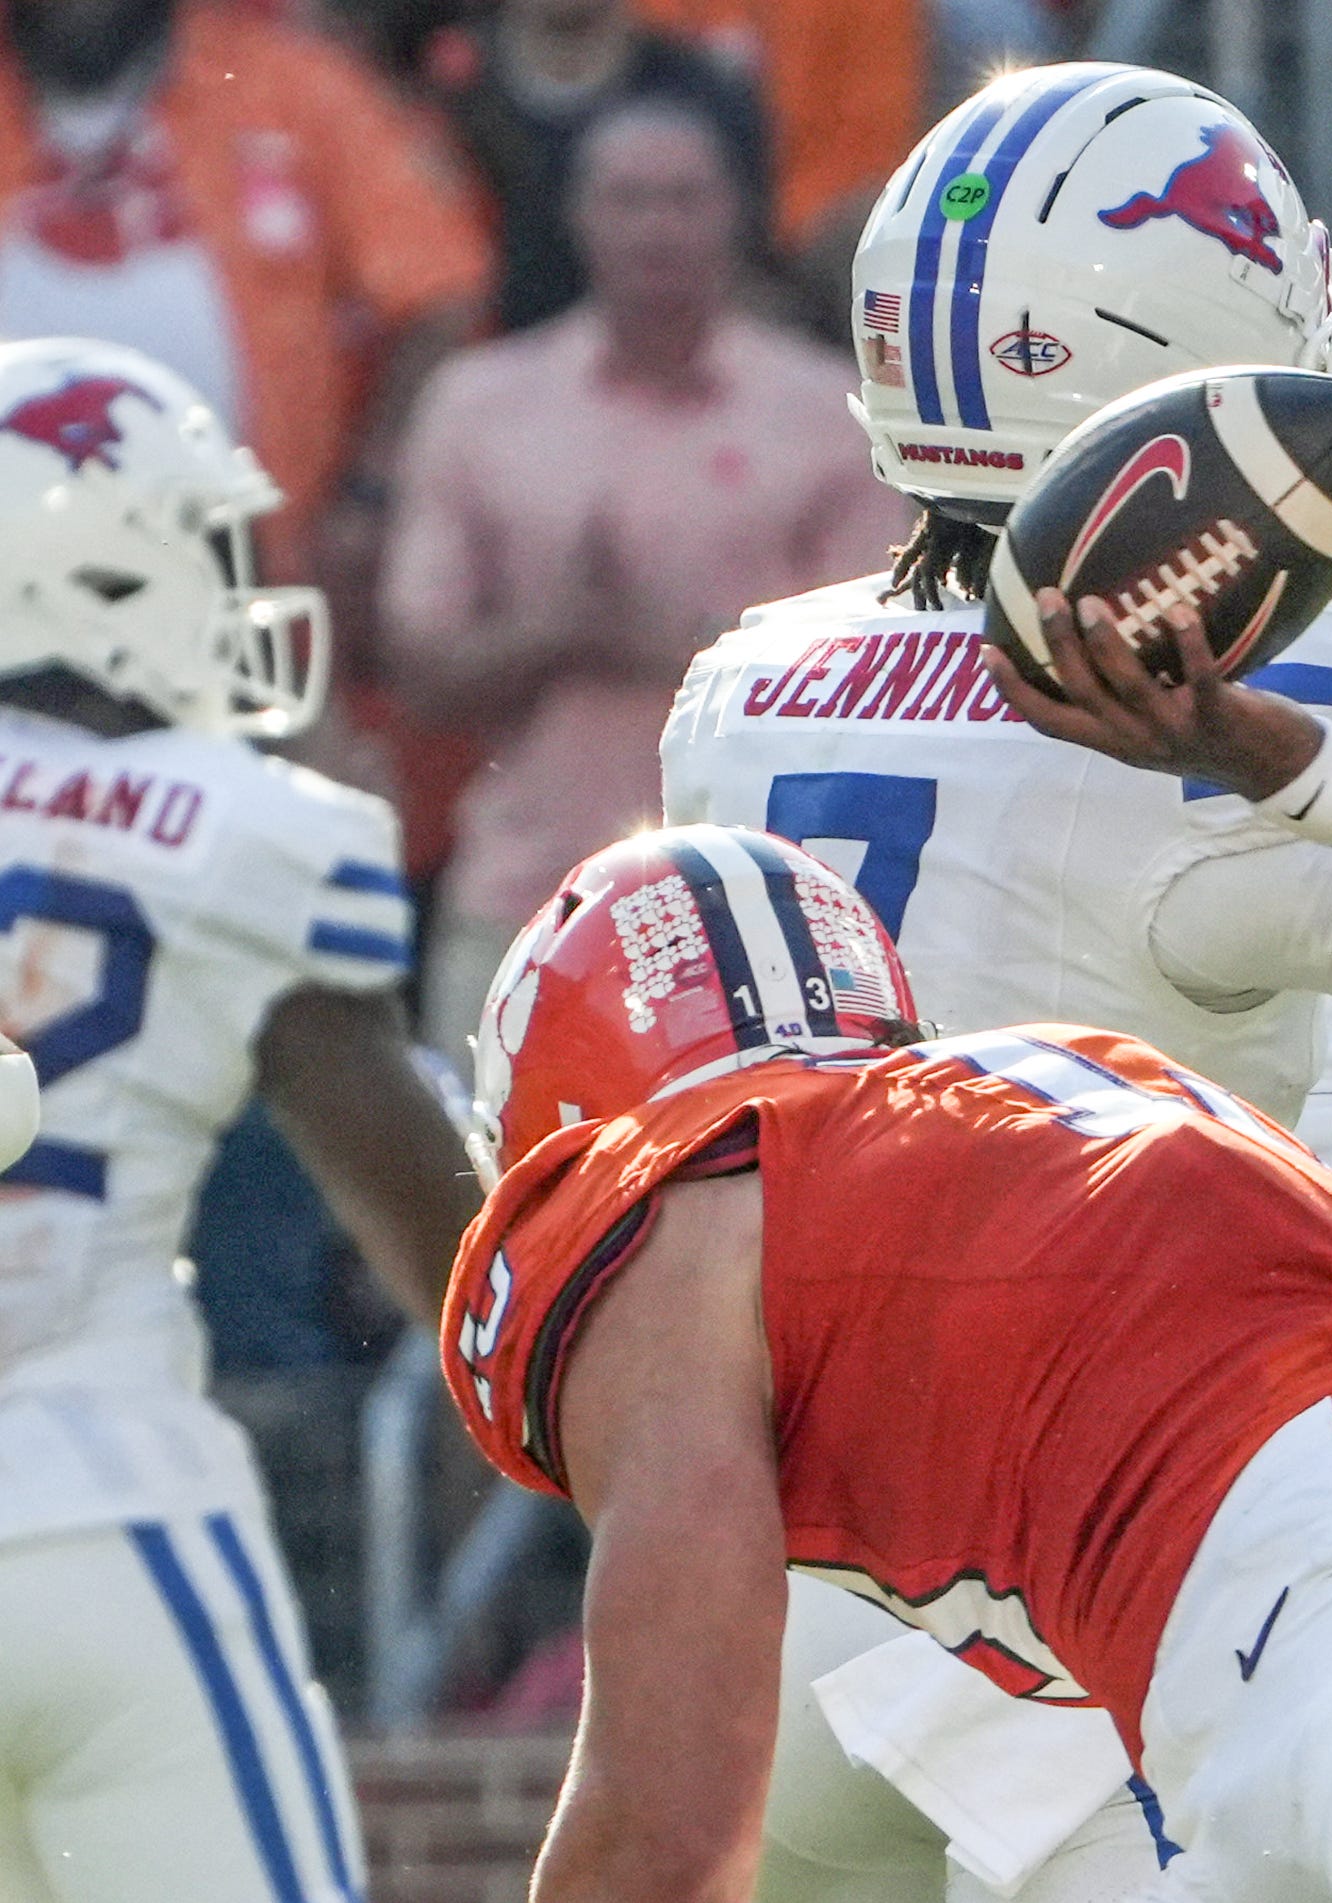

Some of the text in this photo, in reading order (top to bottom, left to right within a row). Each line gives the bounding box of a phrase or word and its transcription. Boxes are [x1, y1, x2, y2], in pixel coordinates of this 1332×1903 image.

[946, 184, 985, 204] C2P
[1001, 340, 1060, 358] ACC
[898, 442, 1024, 470] MUSTANGS
[743, 631, 1027, 722] JENNIN
[0, 757, 206, 846] LAND
[766, 771, 938, 946] 7
